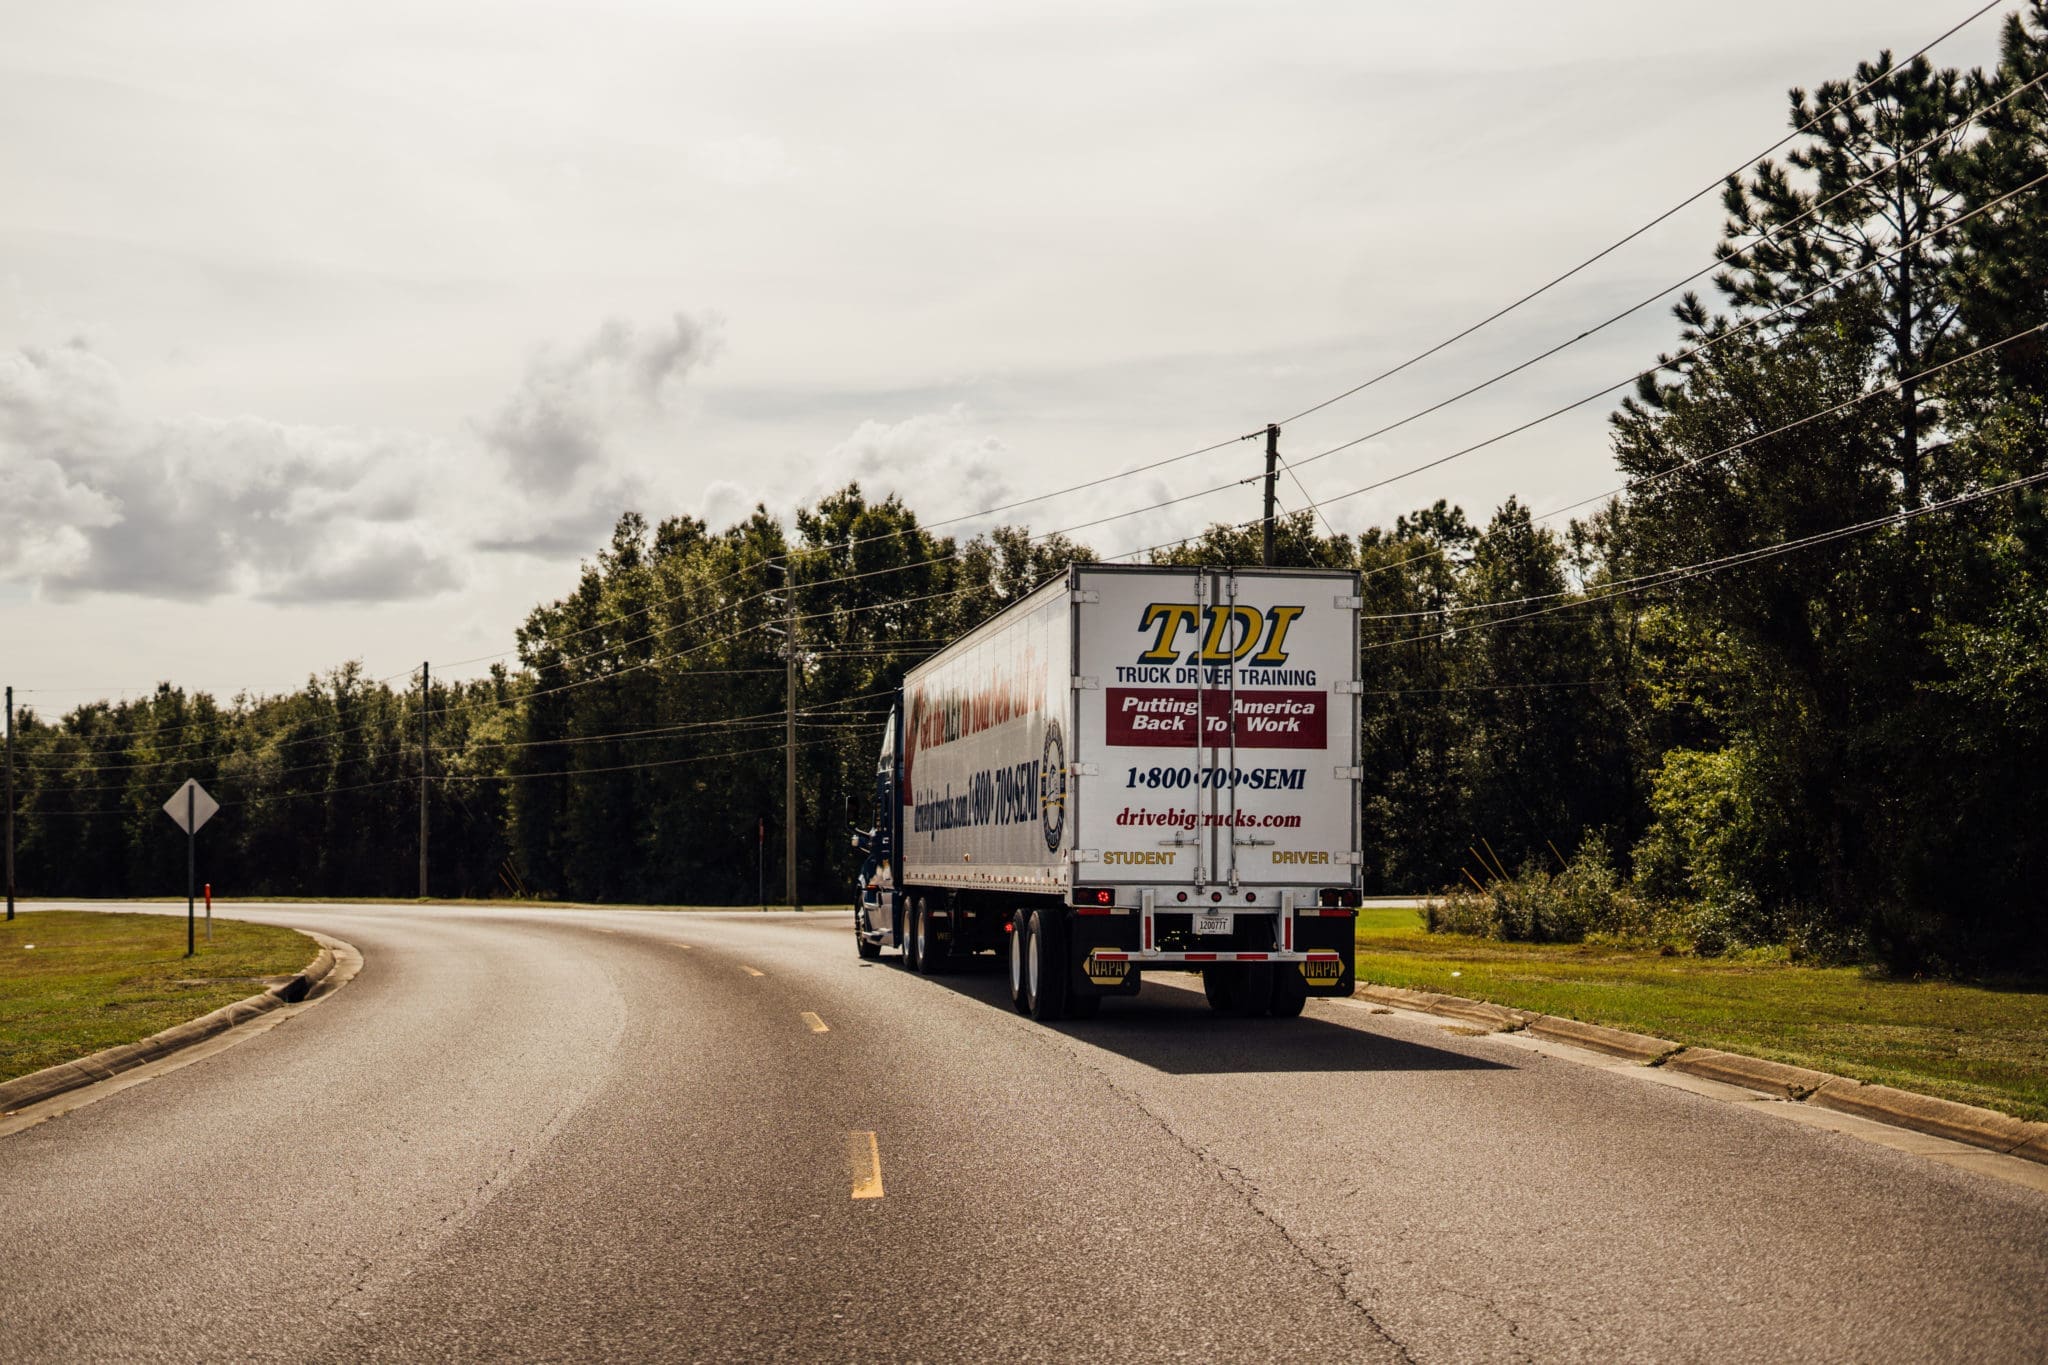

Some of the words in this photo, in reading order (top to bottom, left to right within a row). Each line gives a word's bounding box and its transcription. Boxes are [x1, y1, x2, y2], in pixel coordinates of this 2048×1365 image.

[1137, 603, 1305, 667] TDI
[1116, 666, 1170, 684] TRUCK
[1176, 668, 1234, 685] DRVER
[1239, 669, 1316, 686] TRAINING
[1122, 697, 1199, 716] Putting
[1229, 698, 1315, 715] America
[1132, 715, 1185, 730] Back
[1206, 716, 1228, 732] To
[1247, 716, 1300, 732] Work
[1116, 807, 1302, 830] drivebigrucks.com
[1103, 851, 1176, 865] STUDENT
[1272, 851, 1329, 864] DRIVER
[1091, 957, 1123, 976] NAPA
[1307, 959, 1337, 977] NAPA
